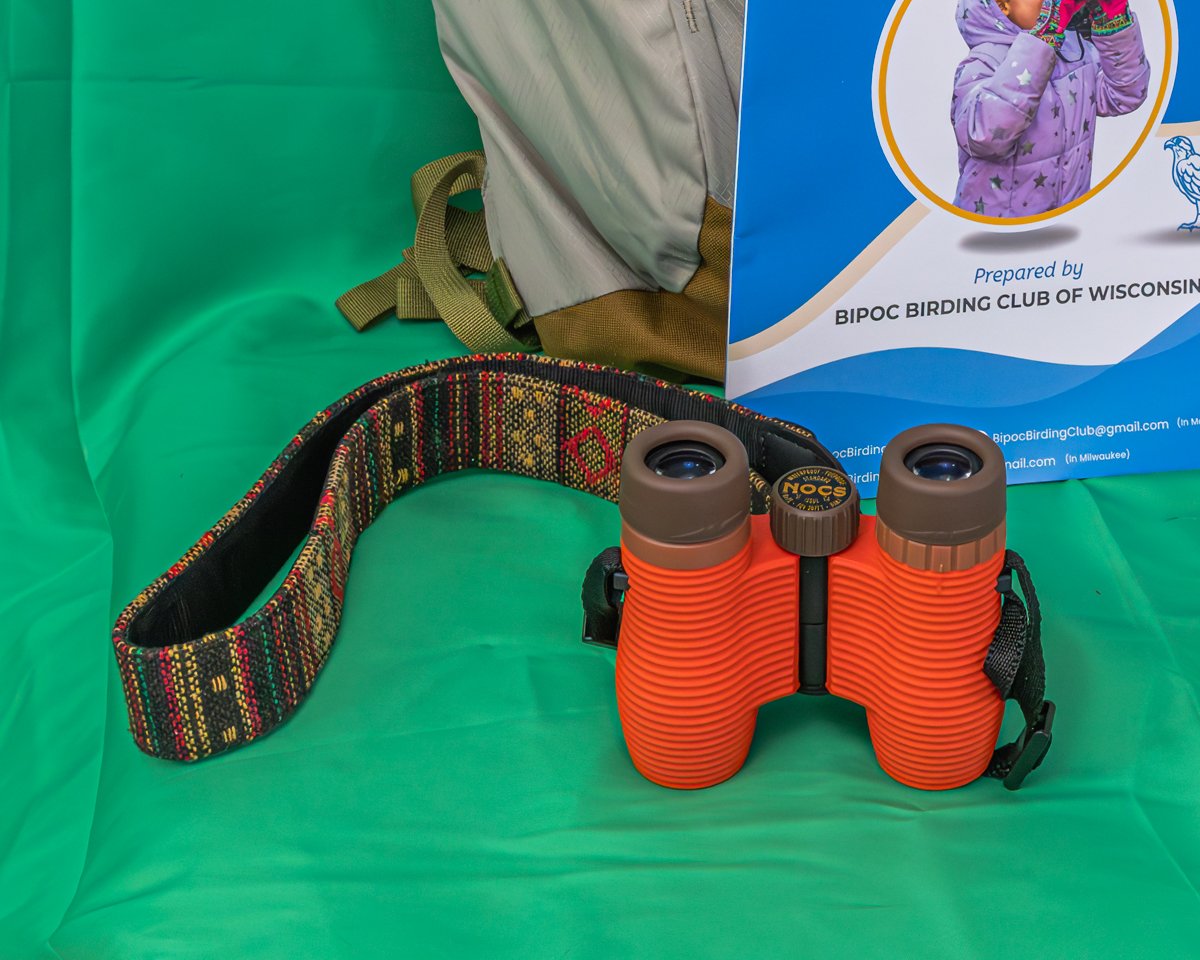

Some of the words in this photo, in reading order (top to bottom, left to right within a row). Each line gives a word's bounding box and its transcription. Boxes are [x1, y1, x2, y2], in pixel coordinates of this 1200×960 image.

[974, 261, 1056, 286] Prepared
[1061, 260, 1084, 280] by
[835, 304, 900, 325] BIPOC
[906, 296, 991, 318] BIRDING
[996, 290, 1050, 310] CLUB
[1055, 287, 1083, 305] OF
[993, 420, 1169, 445] BipocBirdingClub@gmail.com
[1080, 448, 1130, 462] Milwaukee)
[783, 481, 847, 497] NOCS
